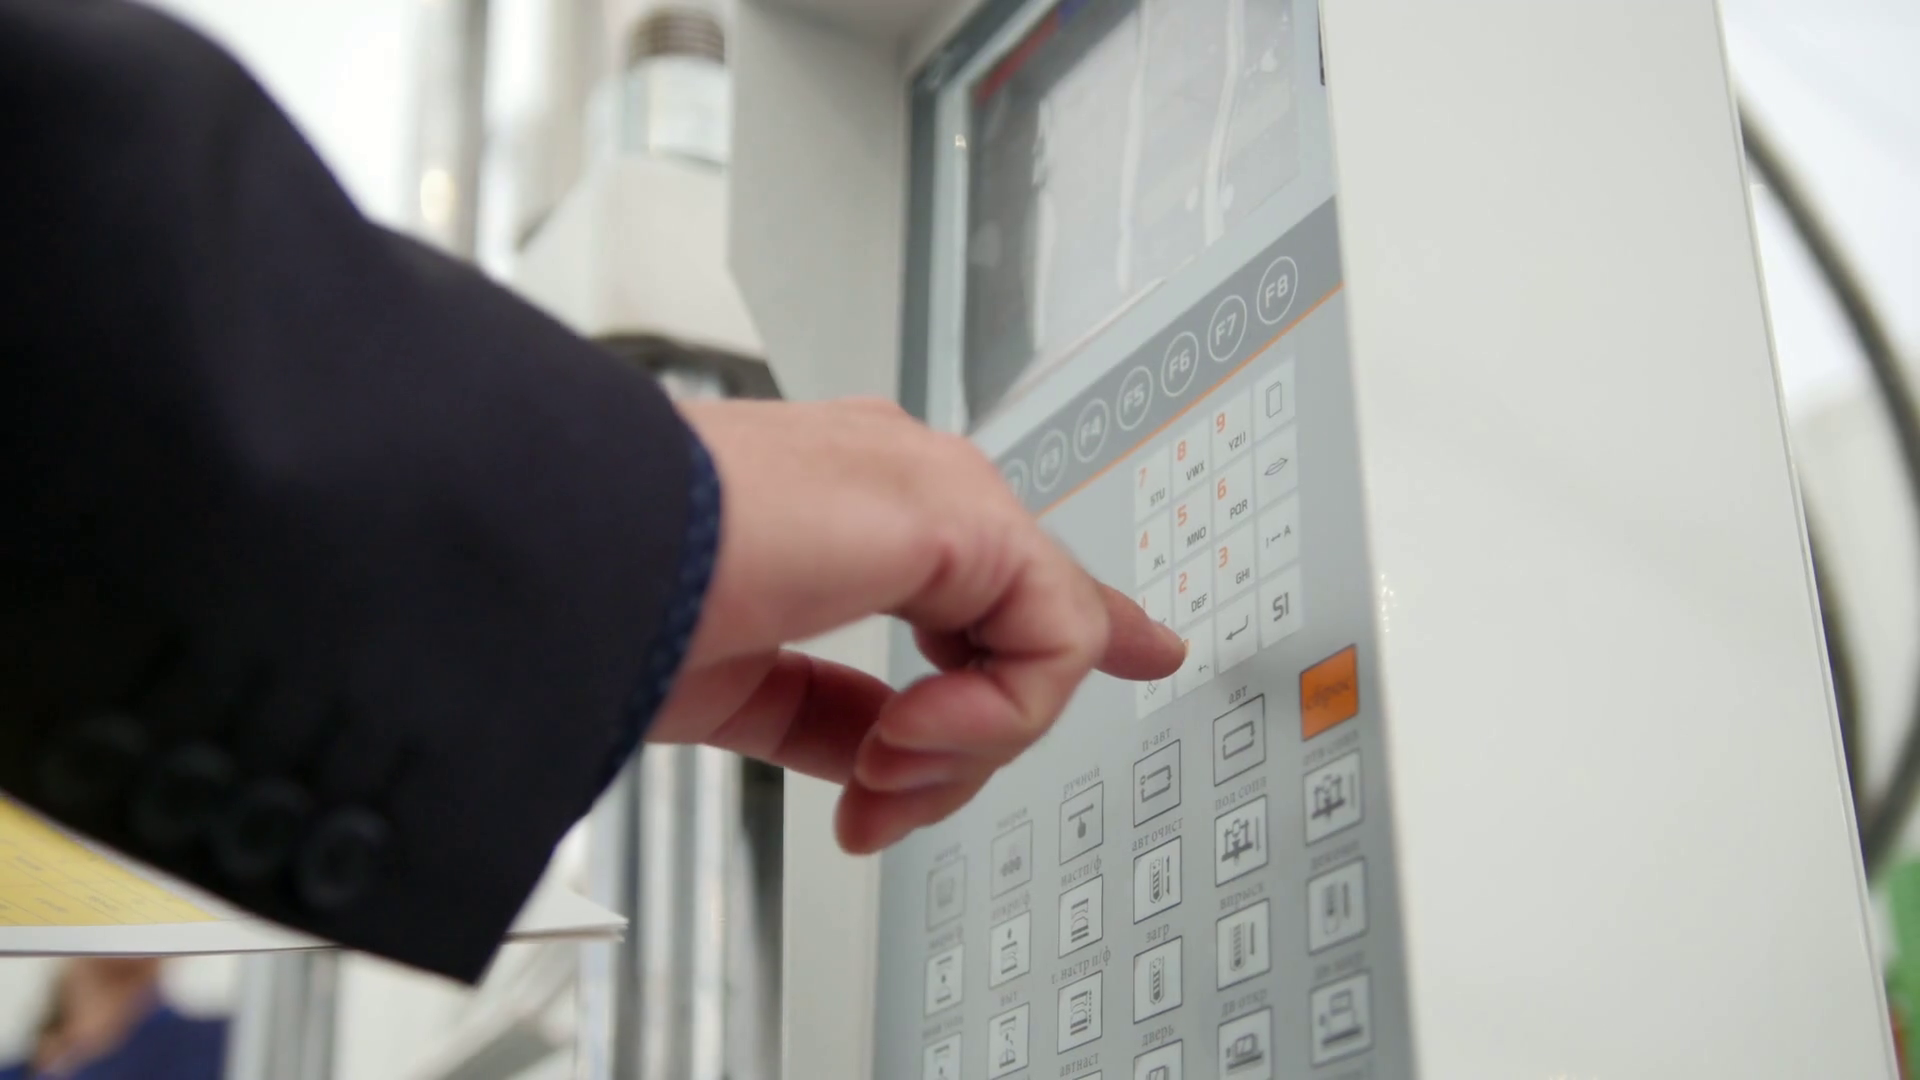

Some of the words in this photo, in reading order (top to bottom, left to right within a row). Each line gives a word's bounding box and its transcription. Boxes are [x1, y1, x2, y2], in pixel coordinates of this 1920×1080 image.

[1264, 274, 1289, 308] F8
[1215, 313, 1237, 345] F7
[1168, 349, 1190, 381] F6
[1123, 383, 1145, 416] F5
[1080, 415, 1101, 447] F4
[1216, 412, 1226, 433] 9
[1177, 440, 1187, 461] 8
[1139, 467, 1147, 488] 7
[1186, 461, 1205, 481] VWX
[1150, 488, 1166, 507] STU
[1217, 478, 1227, 500] 6
[1177, 505, 1187, 526] 5
[1229, 499, 1248, 520] PQR
[1139, 531, 1149, 549] 4
[1186, 526, 1207, 548] MNO
[1152, 554, 1166, 570] JKL
[1218, 546, 1228, 568] 3
[1178, 571, 1188, 594] 2
[1235, 567, 1250, 585] GHI
[1191, 593, 1208, 613] DEF
[1228, 685, 1248, 705] авт
[1142, 728, 1172, 752] п-авт
[1131, 834, 1149, 852] авт
[1151, 817, 1184, 843] очист
[1146, 923, 1170, 944] загр
[1142, 1024, 1175, 1047] дверь
